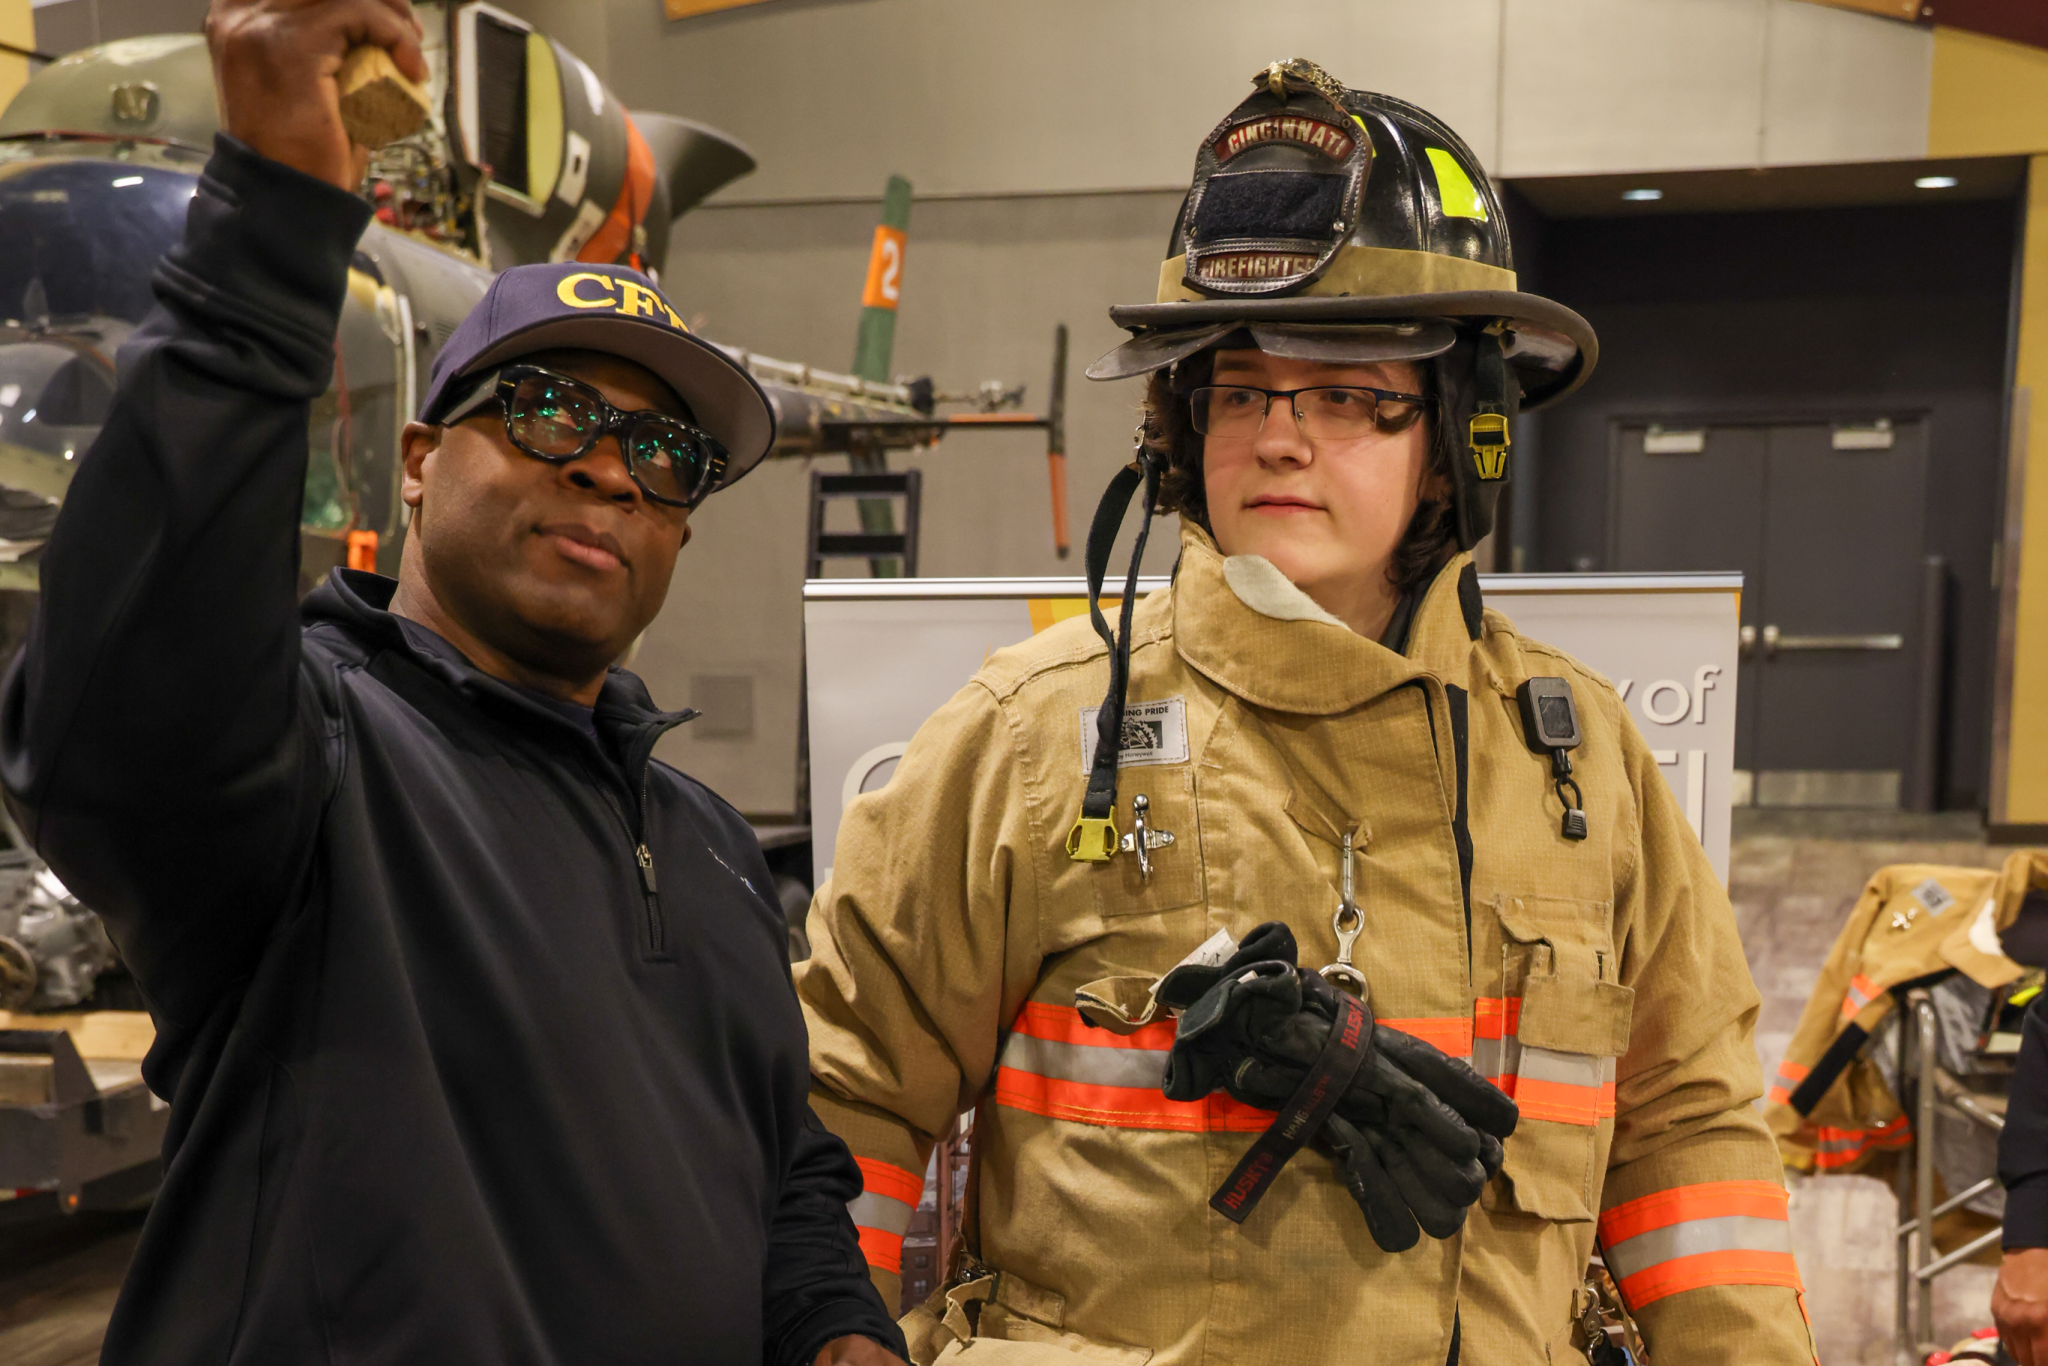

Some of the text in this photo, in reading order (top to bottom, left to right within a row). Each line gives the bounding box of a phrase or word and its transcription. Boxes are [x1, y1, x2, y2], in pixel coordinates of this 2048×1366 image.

[1227, 118, 1347, 155] CINCINNATI
[881, 238, 900, 300] 2
[1145, 706, 1169, 716] PRIDE
[1640, 663, 1723, 726] of
[1125, 751, 1153, 759] Honeywell
